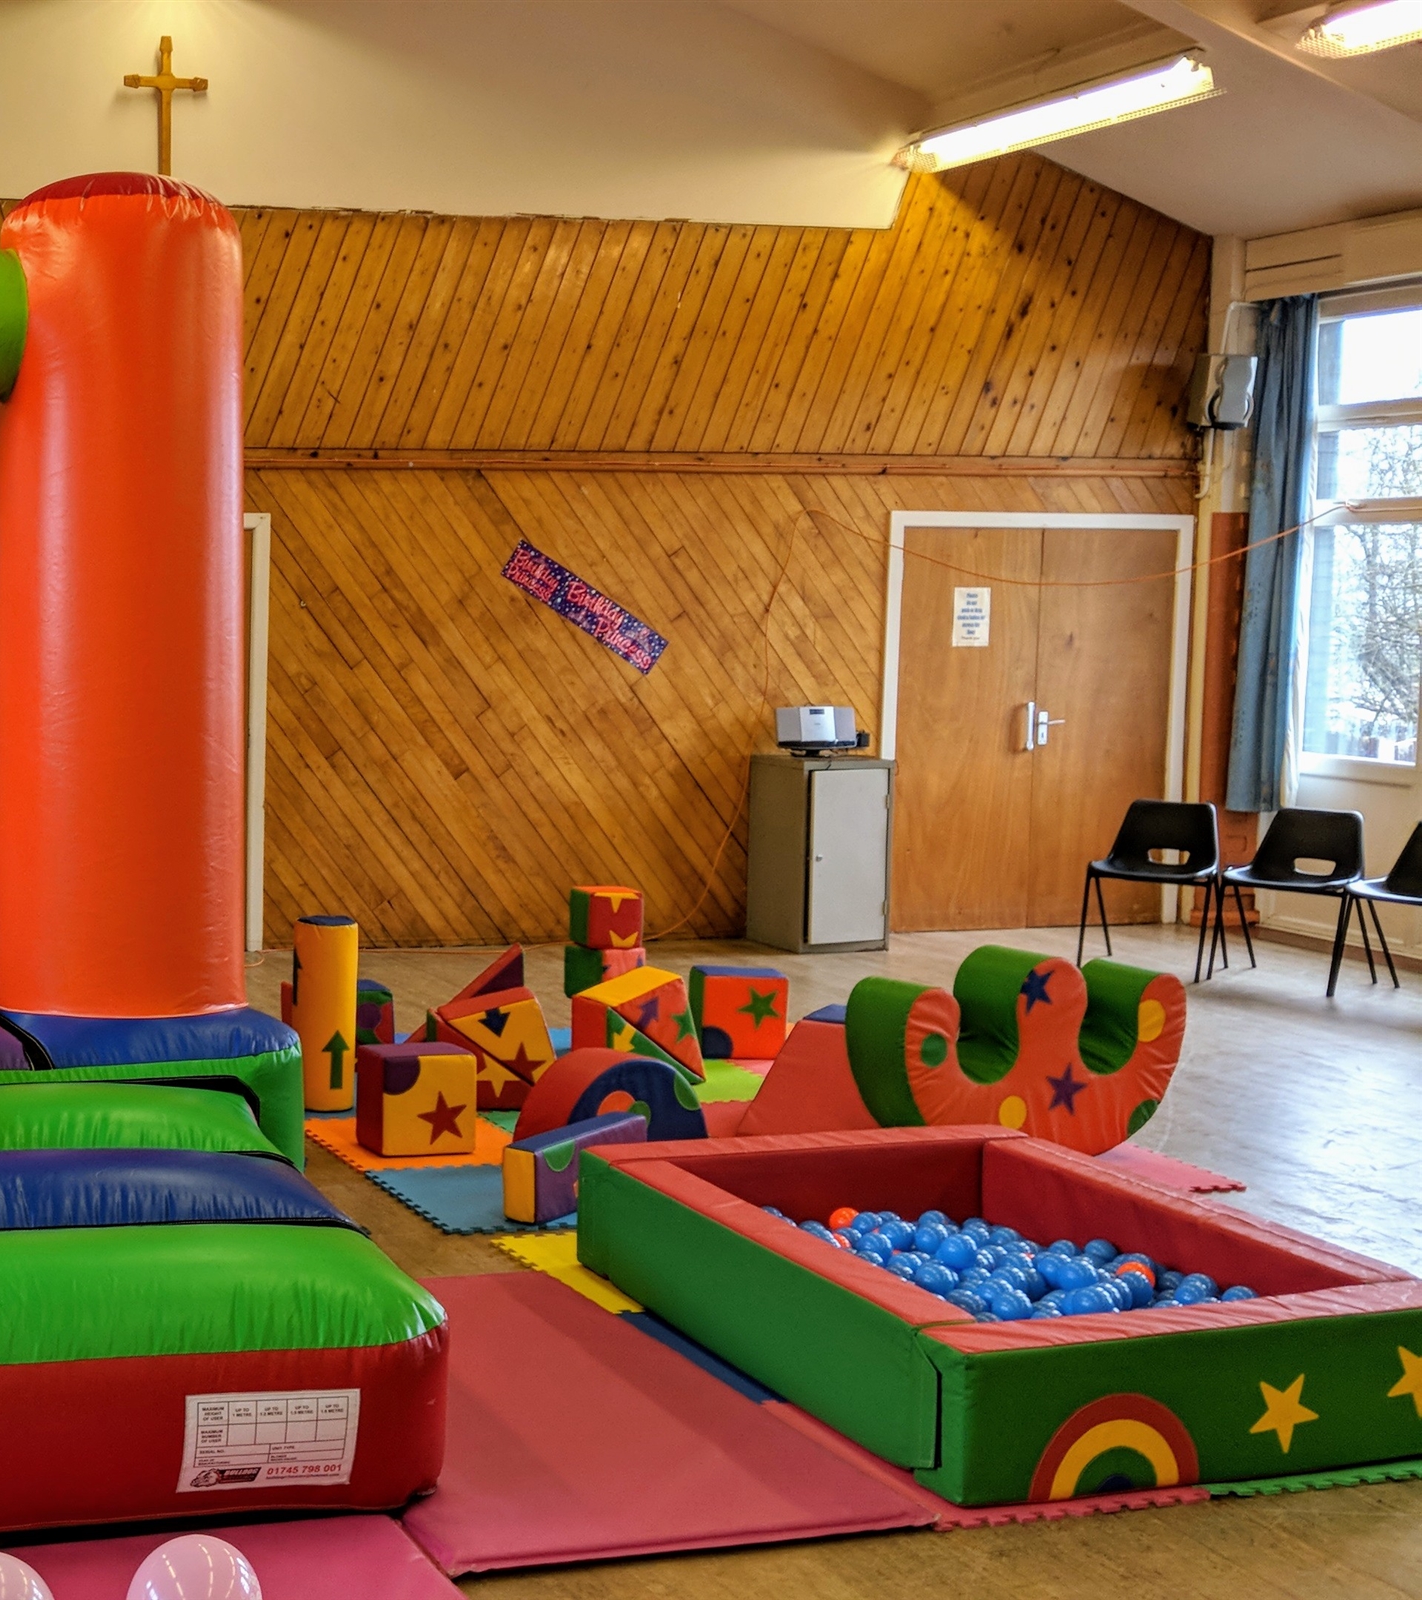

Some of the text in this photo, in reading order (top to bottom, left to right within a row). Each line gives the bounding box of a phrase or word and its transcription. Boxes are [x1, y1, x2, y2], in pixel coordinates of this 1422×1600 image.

[507, 562, 552, 602] Princess
[514, 549, 559, 591] Birthday
[566, 581, 624, 628] Birthday
[593, 617, 652, 669] Princess
[224, 1468, 259, 1476] BULLDOG
[267, 1464, 342, 1475] 01745 798 001
